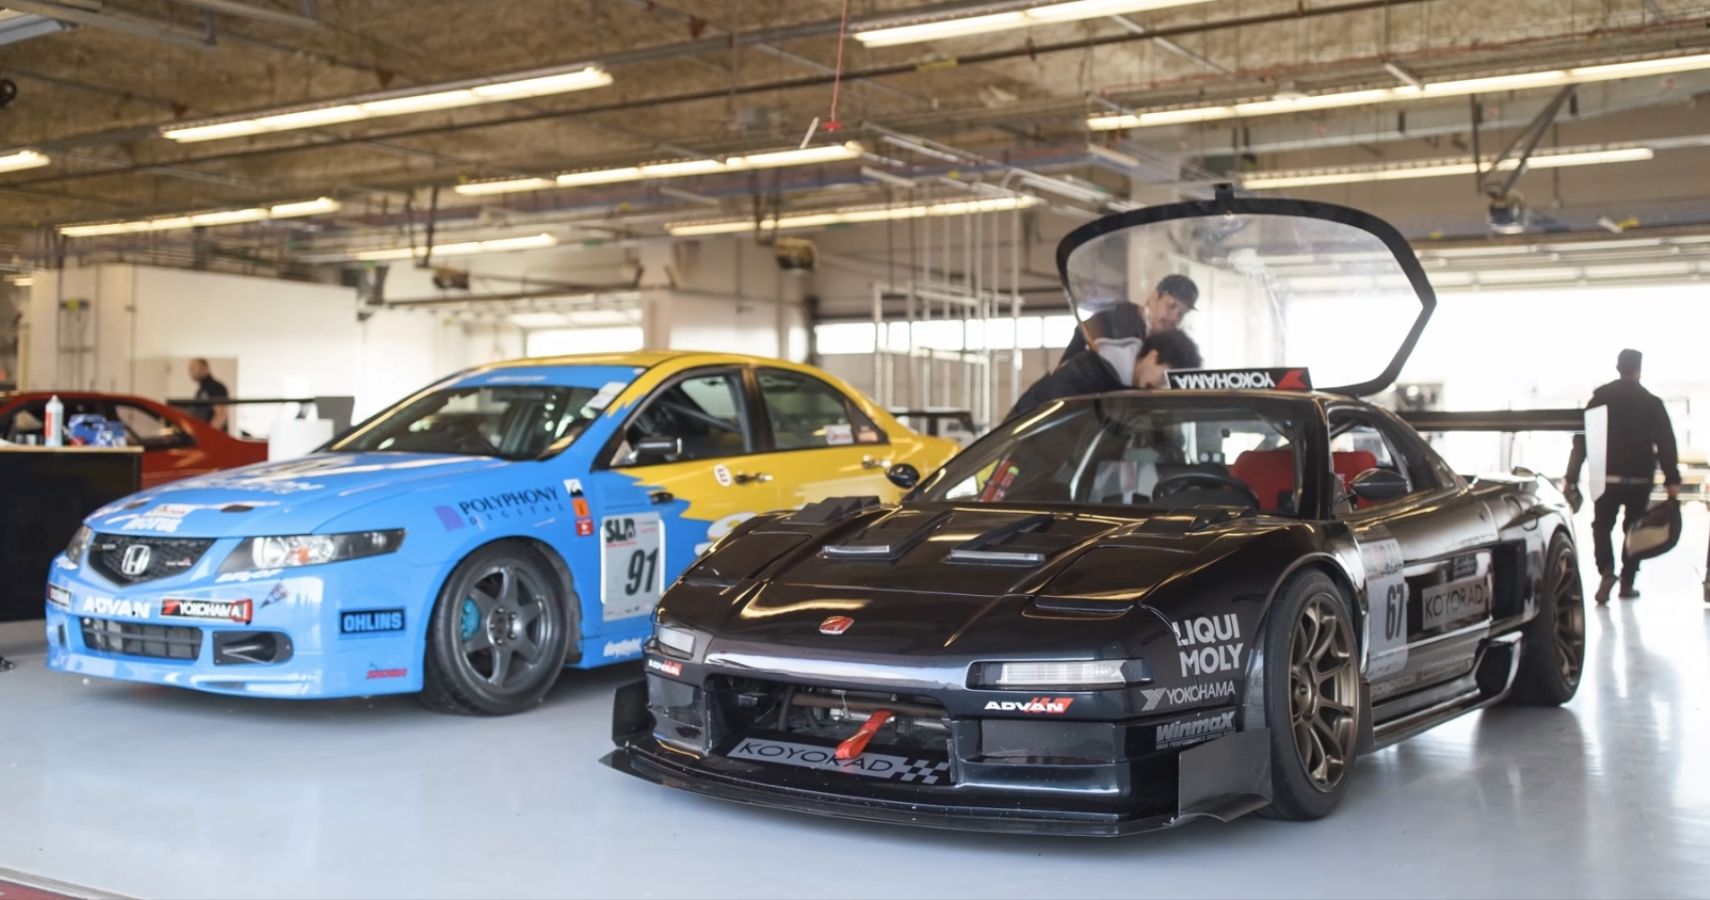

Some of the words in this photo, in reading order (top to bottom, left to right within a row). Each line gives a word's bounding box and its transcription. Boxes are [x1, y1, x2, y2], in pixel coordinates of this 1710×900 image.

[1174, 371, 1276, 390] YOKOHAMA
[458, 486, 559, 515] POLYPHONY
[625, 547, 659, 596] 91
[82, 597, 150, 619] ADVAN
[178, 602, 242, 618] YOKOHAMA
[1385, 582, 1404, 641] 67
[343, 612, 403, 632] OHLINS
[1171, 613, 1240, 647] LIQUI
[1180, 643, 1244, 677] MOLY
[1166, 680, 1236, 705] YOKOHAMA
[984, 700, 1066, 713] ADVAN
